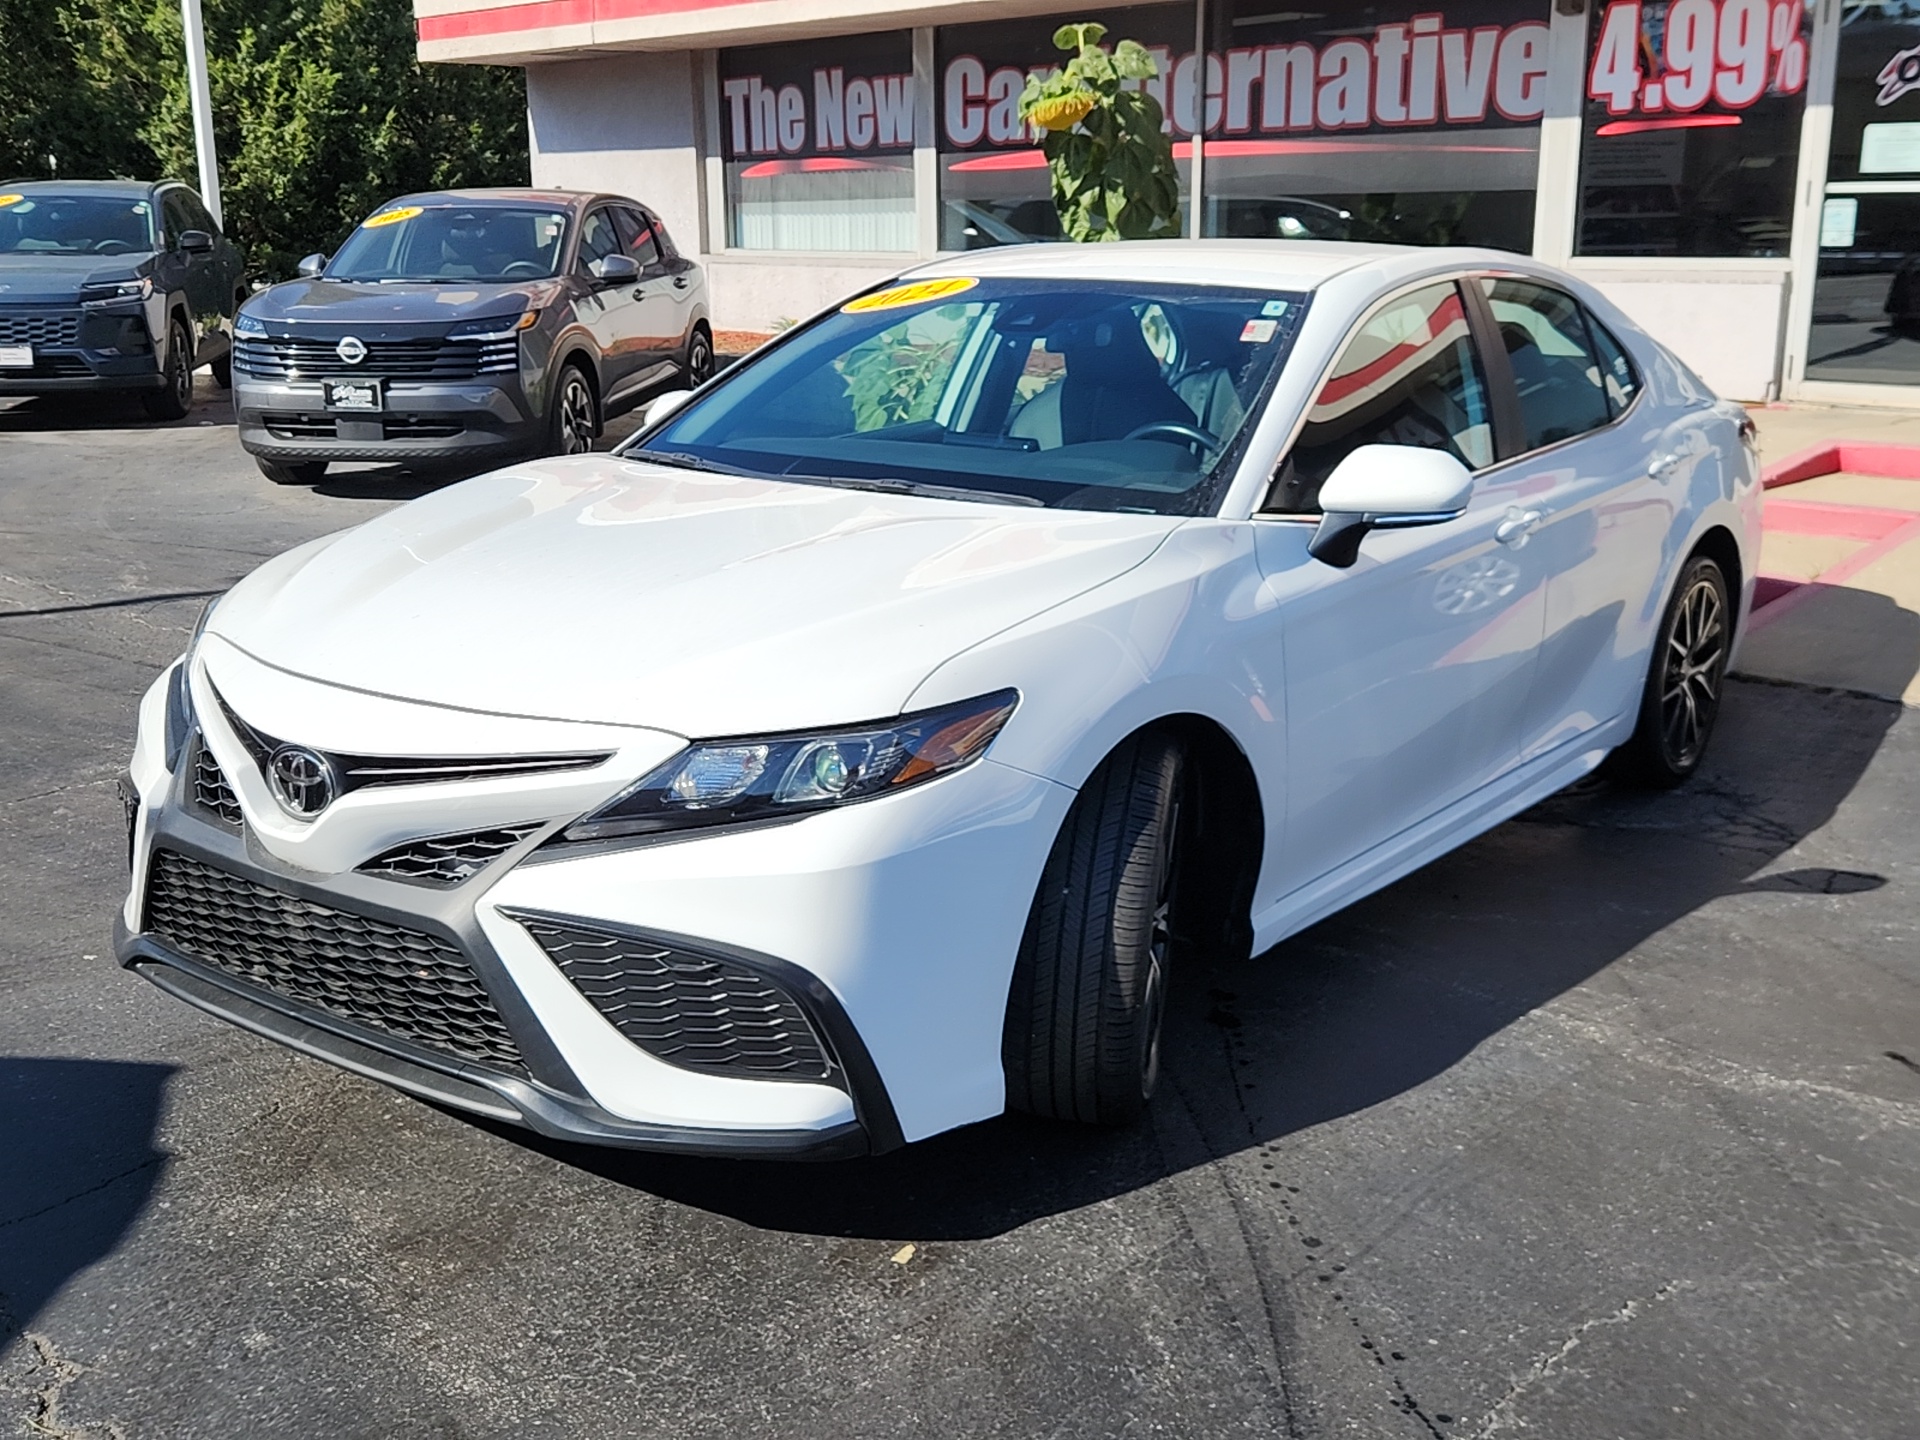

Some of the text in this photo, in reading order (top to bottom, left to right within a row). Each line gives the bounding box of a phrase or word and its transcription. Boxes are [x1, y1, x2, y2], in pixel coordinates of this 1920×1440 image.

[1587, 0, 1809, 116] 4.99%
[723, 74, 806, 156] The
[812, 66, 914, 151] New
[850, 278, 971, 310] 2024
